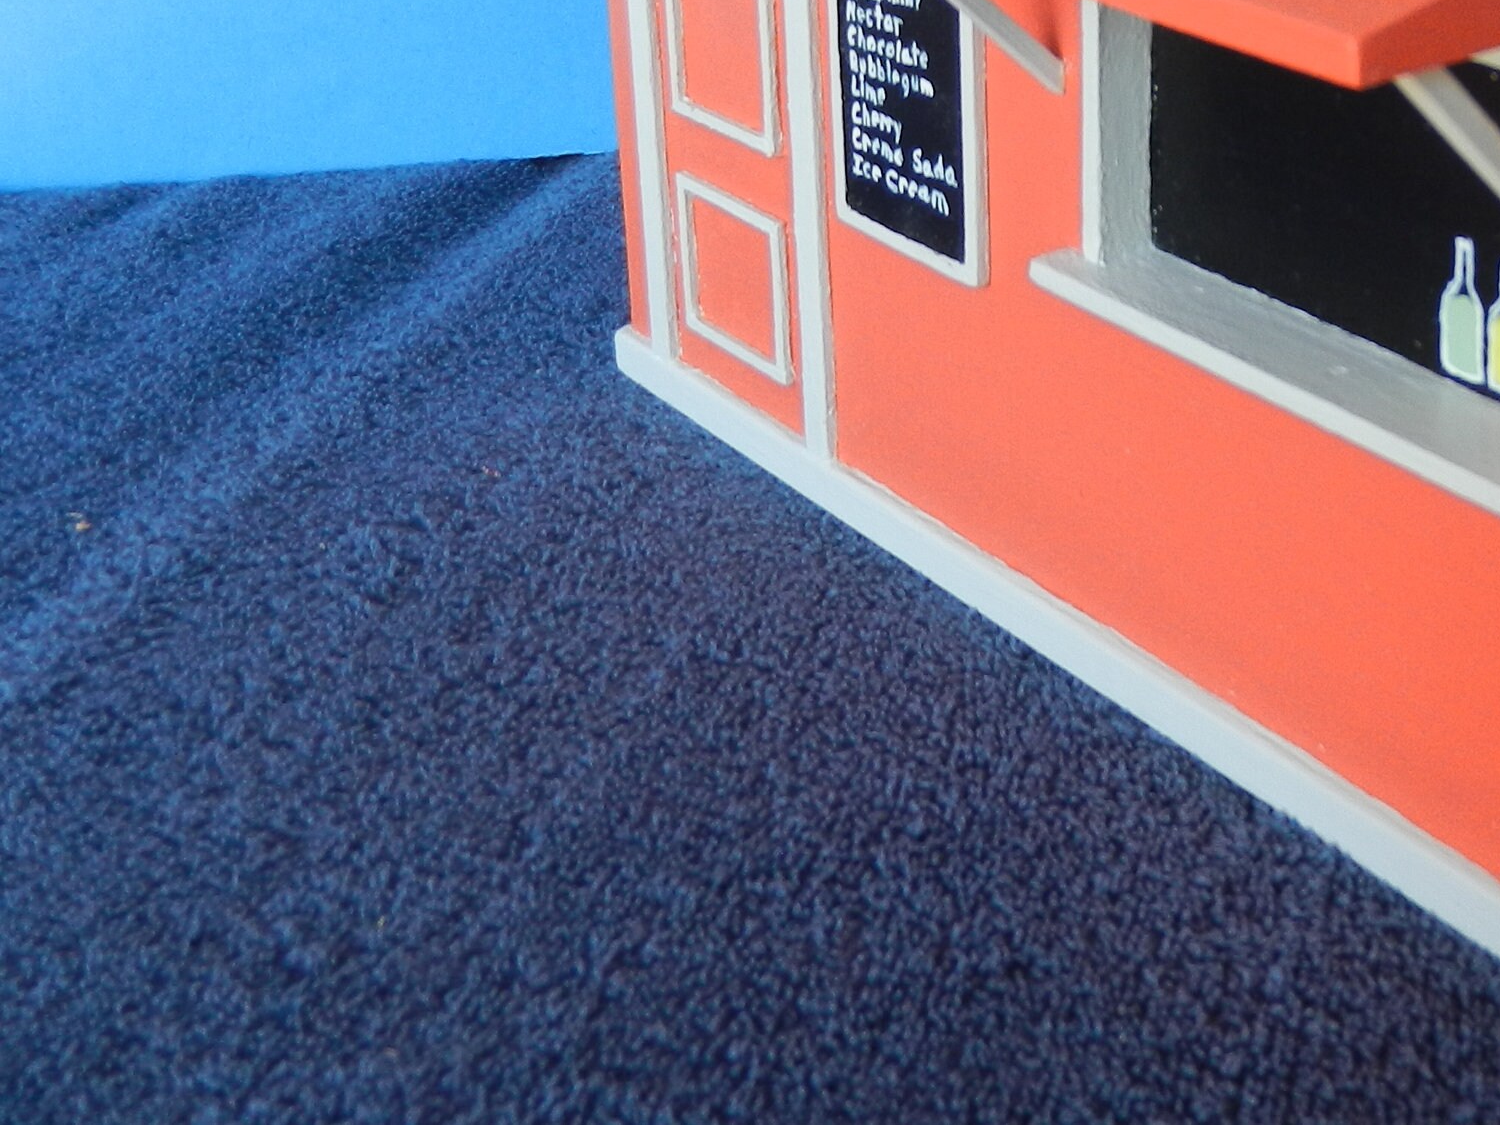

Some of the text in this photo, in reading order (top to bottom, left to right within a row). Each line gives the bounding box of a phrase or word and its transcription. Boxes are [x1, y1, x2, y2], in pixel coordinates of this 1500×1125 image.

[846, 0, 903, 37] Nectar
[847, 23, 928, 70] Chocolate
[849, 49, 935, 98] Bubblegum
[851, 73, 886, 106] Lime
[851, 101, 902, 144] Cherry
[852, 127, 904, 167] Creme
[852, 152, 949, 216] Ice Cream
